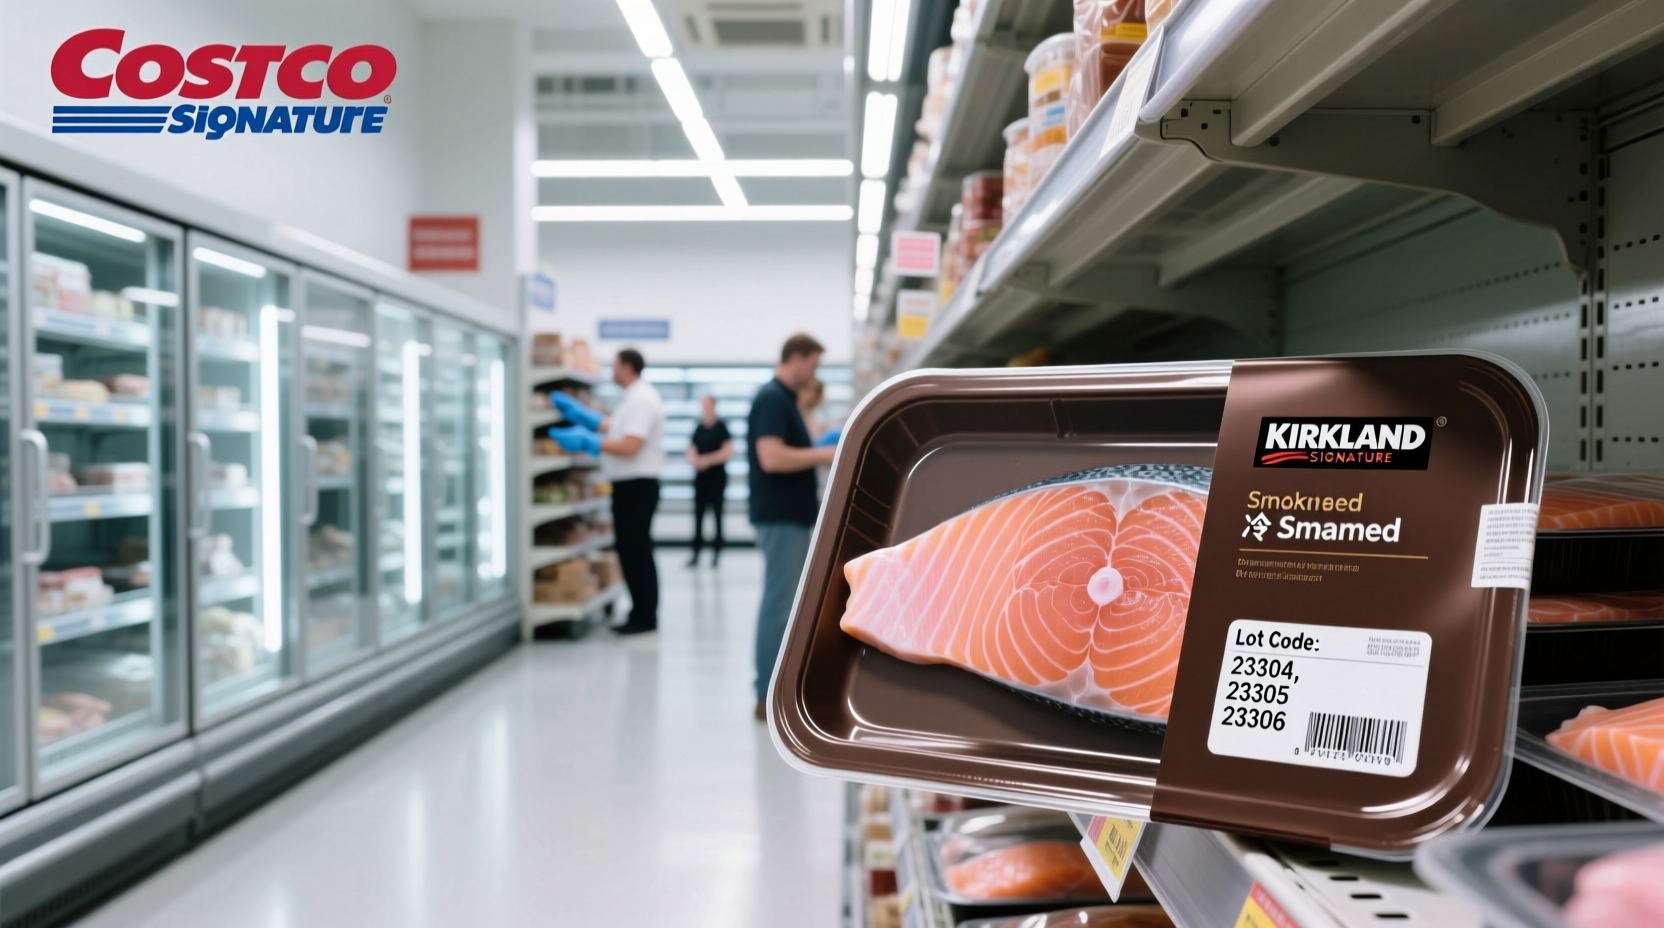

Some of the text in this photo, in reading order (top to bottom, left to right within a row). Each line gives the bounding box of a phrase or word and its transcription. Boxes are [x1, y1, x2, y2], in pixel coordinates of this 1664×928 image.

[1265, 423, 1426, 450] KIRKLAND
[1310, 451, 1393, 463] SIGNATURE
[1276, 515, 1401, 543] Smamed
[1235, 628, 1320, 652] Lot Code:
[1230, 655, 1300, 685] 23304,
[1225, 680, 1290, 705] 23305
[1221, 705, 1287, 732] 23306
